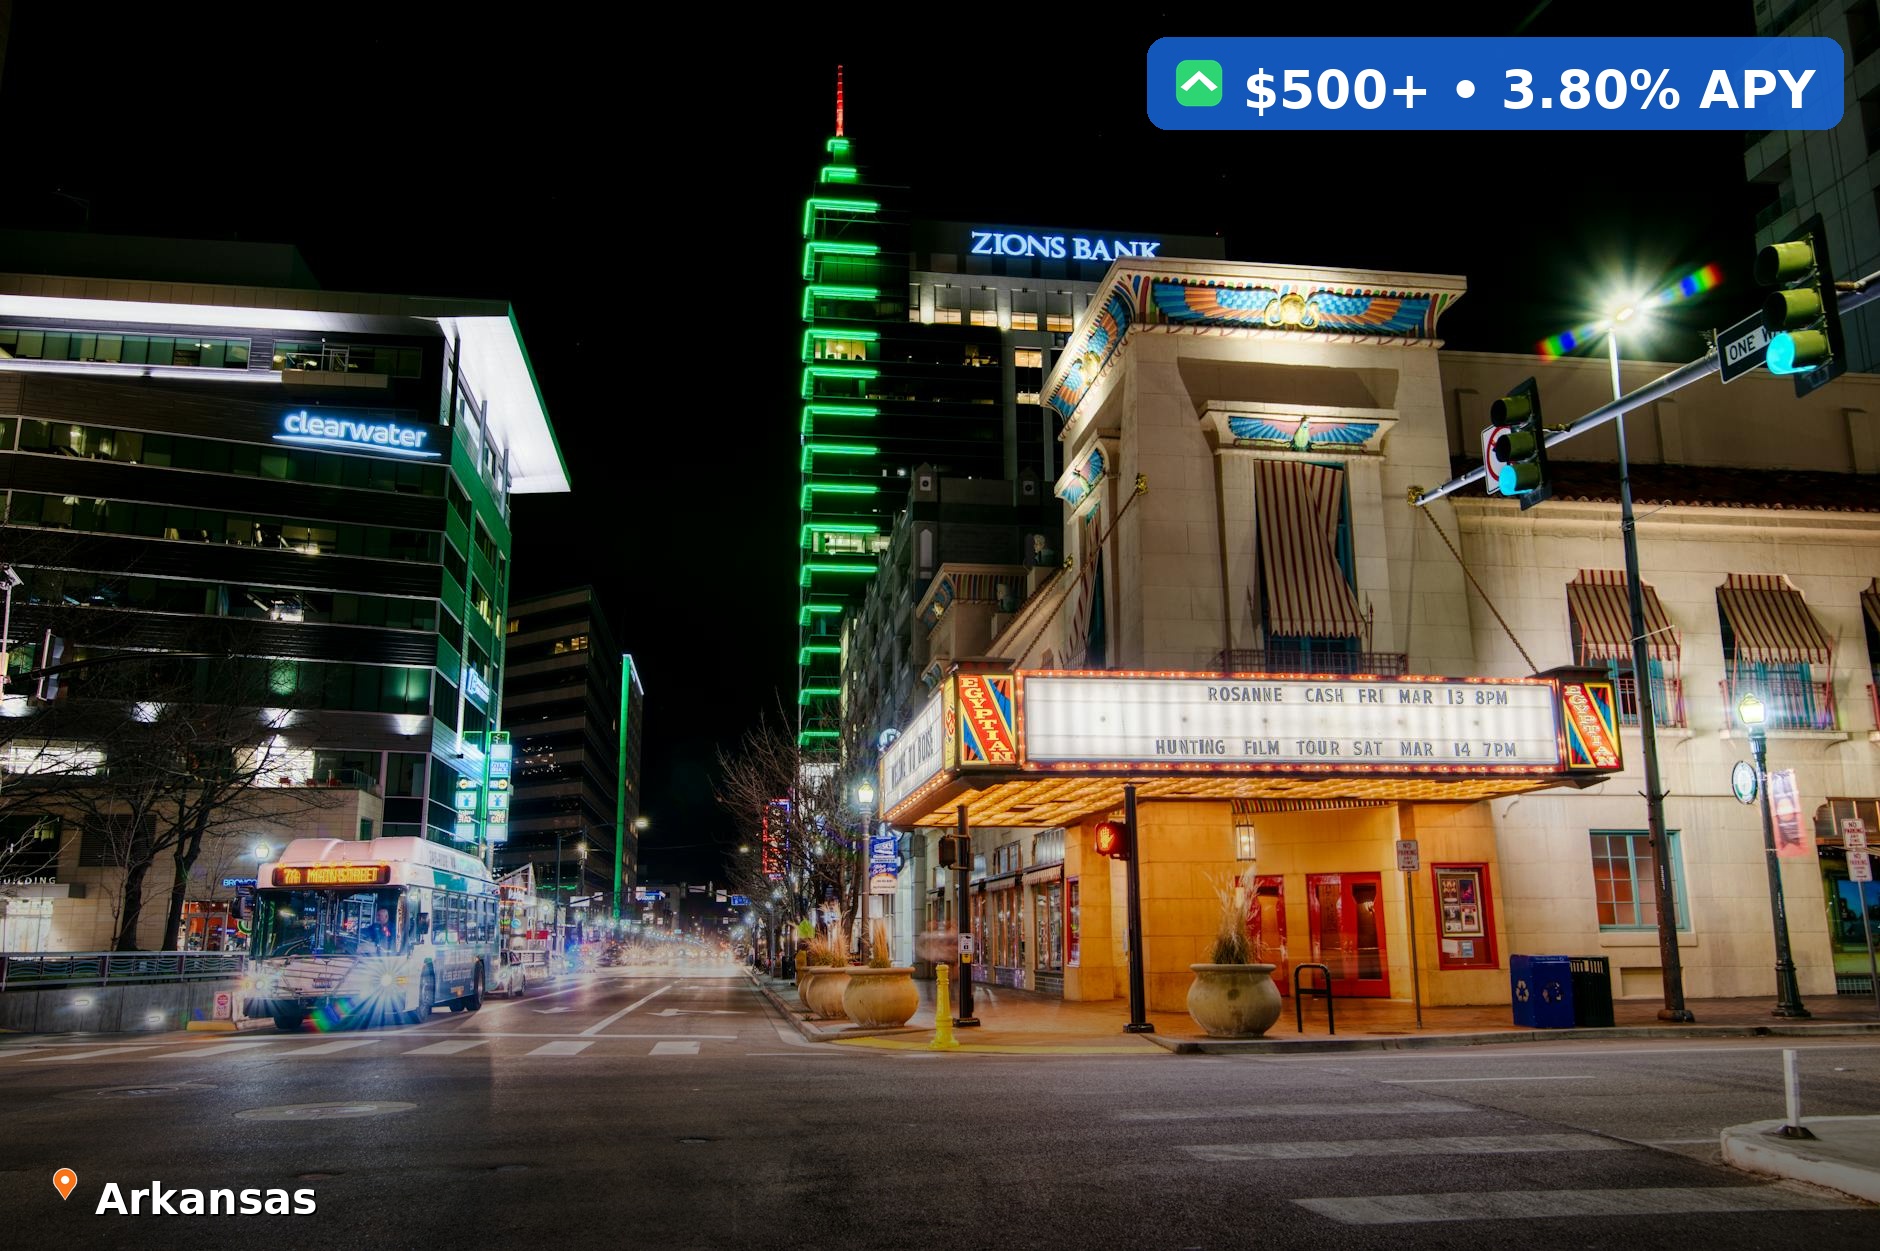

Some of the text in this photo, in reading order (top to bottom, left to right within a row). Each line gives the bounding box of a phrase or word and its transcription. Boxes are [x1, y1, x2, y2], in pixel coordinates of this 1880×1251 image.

[971, 230, 1161, 261] ZIONS BANK
[1729, 334, 1757, 361] ONE
[284, 410, 428, 448] clearwater
[1208, 686, 1508, 705] ROSANNE CASH FRI MAR 13 8PM
[961, 677, 1014, 763] EGYPTIAN
[1563, 684, 1618, 767] EGYPTIAN
[1155, 739, 1517, 757] HUNTING FILM TOUR SAT MAR 14 7PM
[0, 876, 56, 885] UILDING
